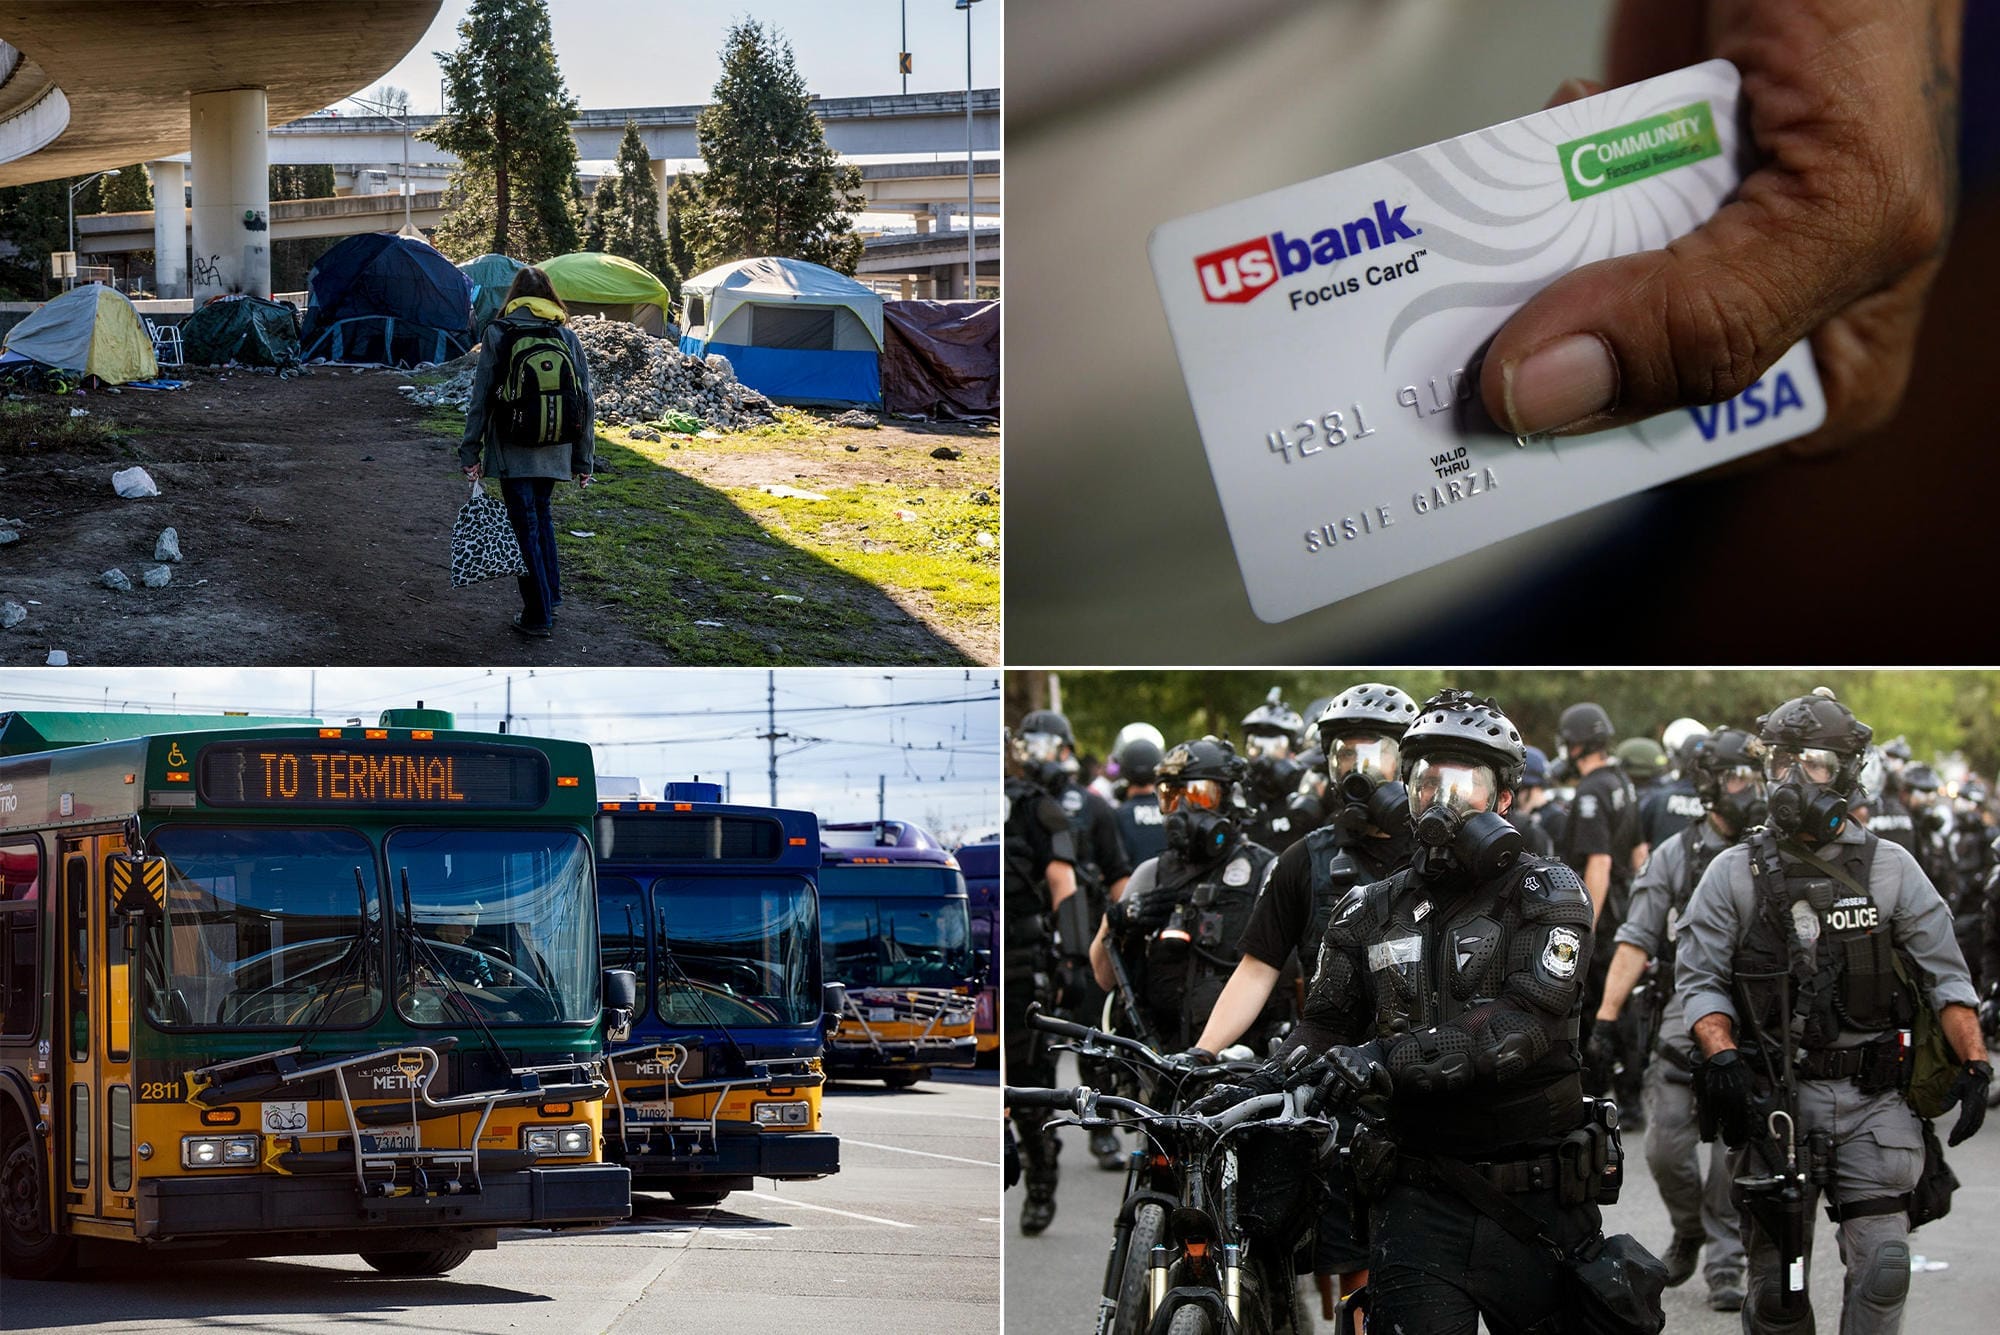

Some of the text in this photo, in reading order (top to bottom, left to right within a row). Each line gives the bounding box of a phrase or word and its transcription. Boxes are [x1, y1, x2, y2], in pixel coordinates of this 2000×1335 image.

[1570, 115, 1700, 188] COMMUNITY
[1288, 276, 1361, 311] Focus
[1686, 369, 1805, 443] VISA
[1266, 400, 1376, 464] 4281
[1430, 446, 1467, 468] VALID
[1434, 458, 1471, 480] THRU
[1303, 466, 1500, 554] SUSIE GARZA
[260, 753, 464, 800] TO TERMINAL
[141, 1081, 180, 1100] 2811
